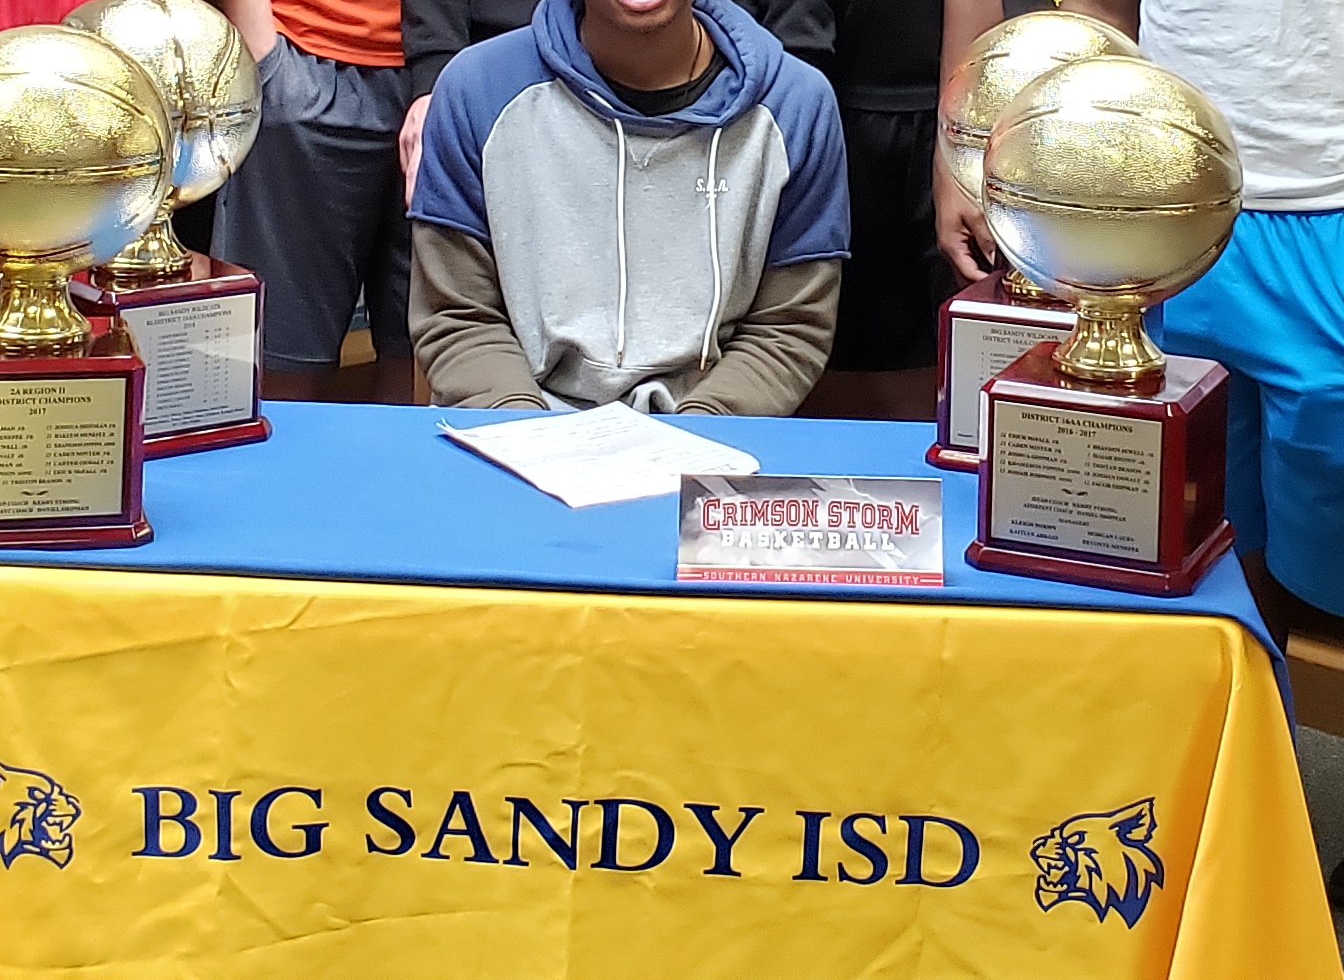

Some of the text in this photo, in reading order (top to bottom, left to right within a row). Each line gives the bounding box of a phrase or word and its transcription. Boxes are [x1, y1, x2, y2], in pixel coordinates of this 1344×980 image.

[982, 335, 1010, 345] DISTRICT
[9, 387, 21, 396] 2A
[22, 387, 57, 396] REGION
[38, 396, 92, 405] CHAMPIONS
[28, 407, 47, 416] 2017
[1021, 411, 1060, 424] DISTRICT
[1083, 420, 1133, 434] CHAMPIONS
[1057, 426, 1096, 438] 2016 2017
[702, 498, 920, 535] CRIMSON STORM
[721, 529, 896, 551] BASKETBALL
[702, 571, 920, 585] SOUTHERN NAZARENE UNIVERSITY
[131, 785, 982, 889] BIG SANDY ISD
